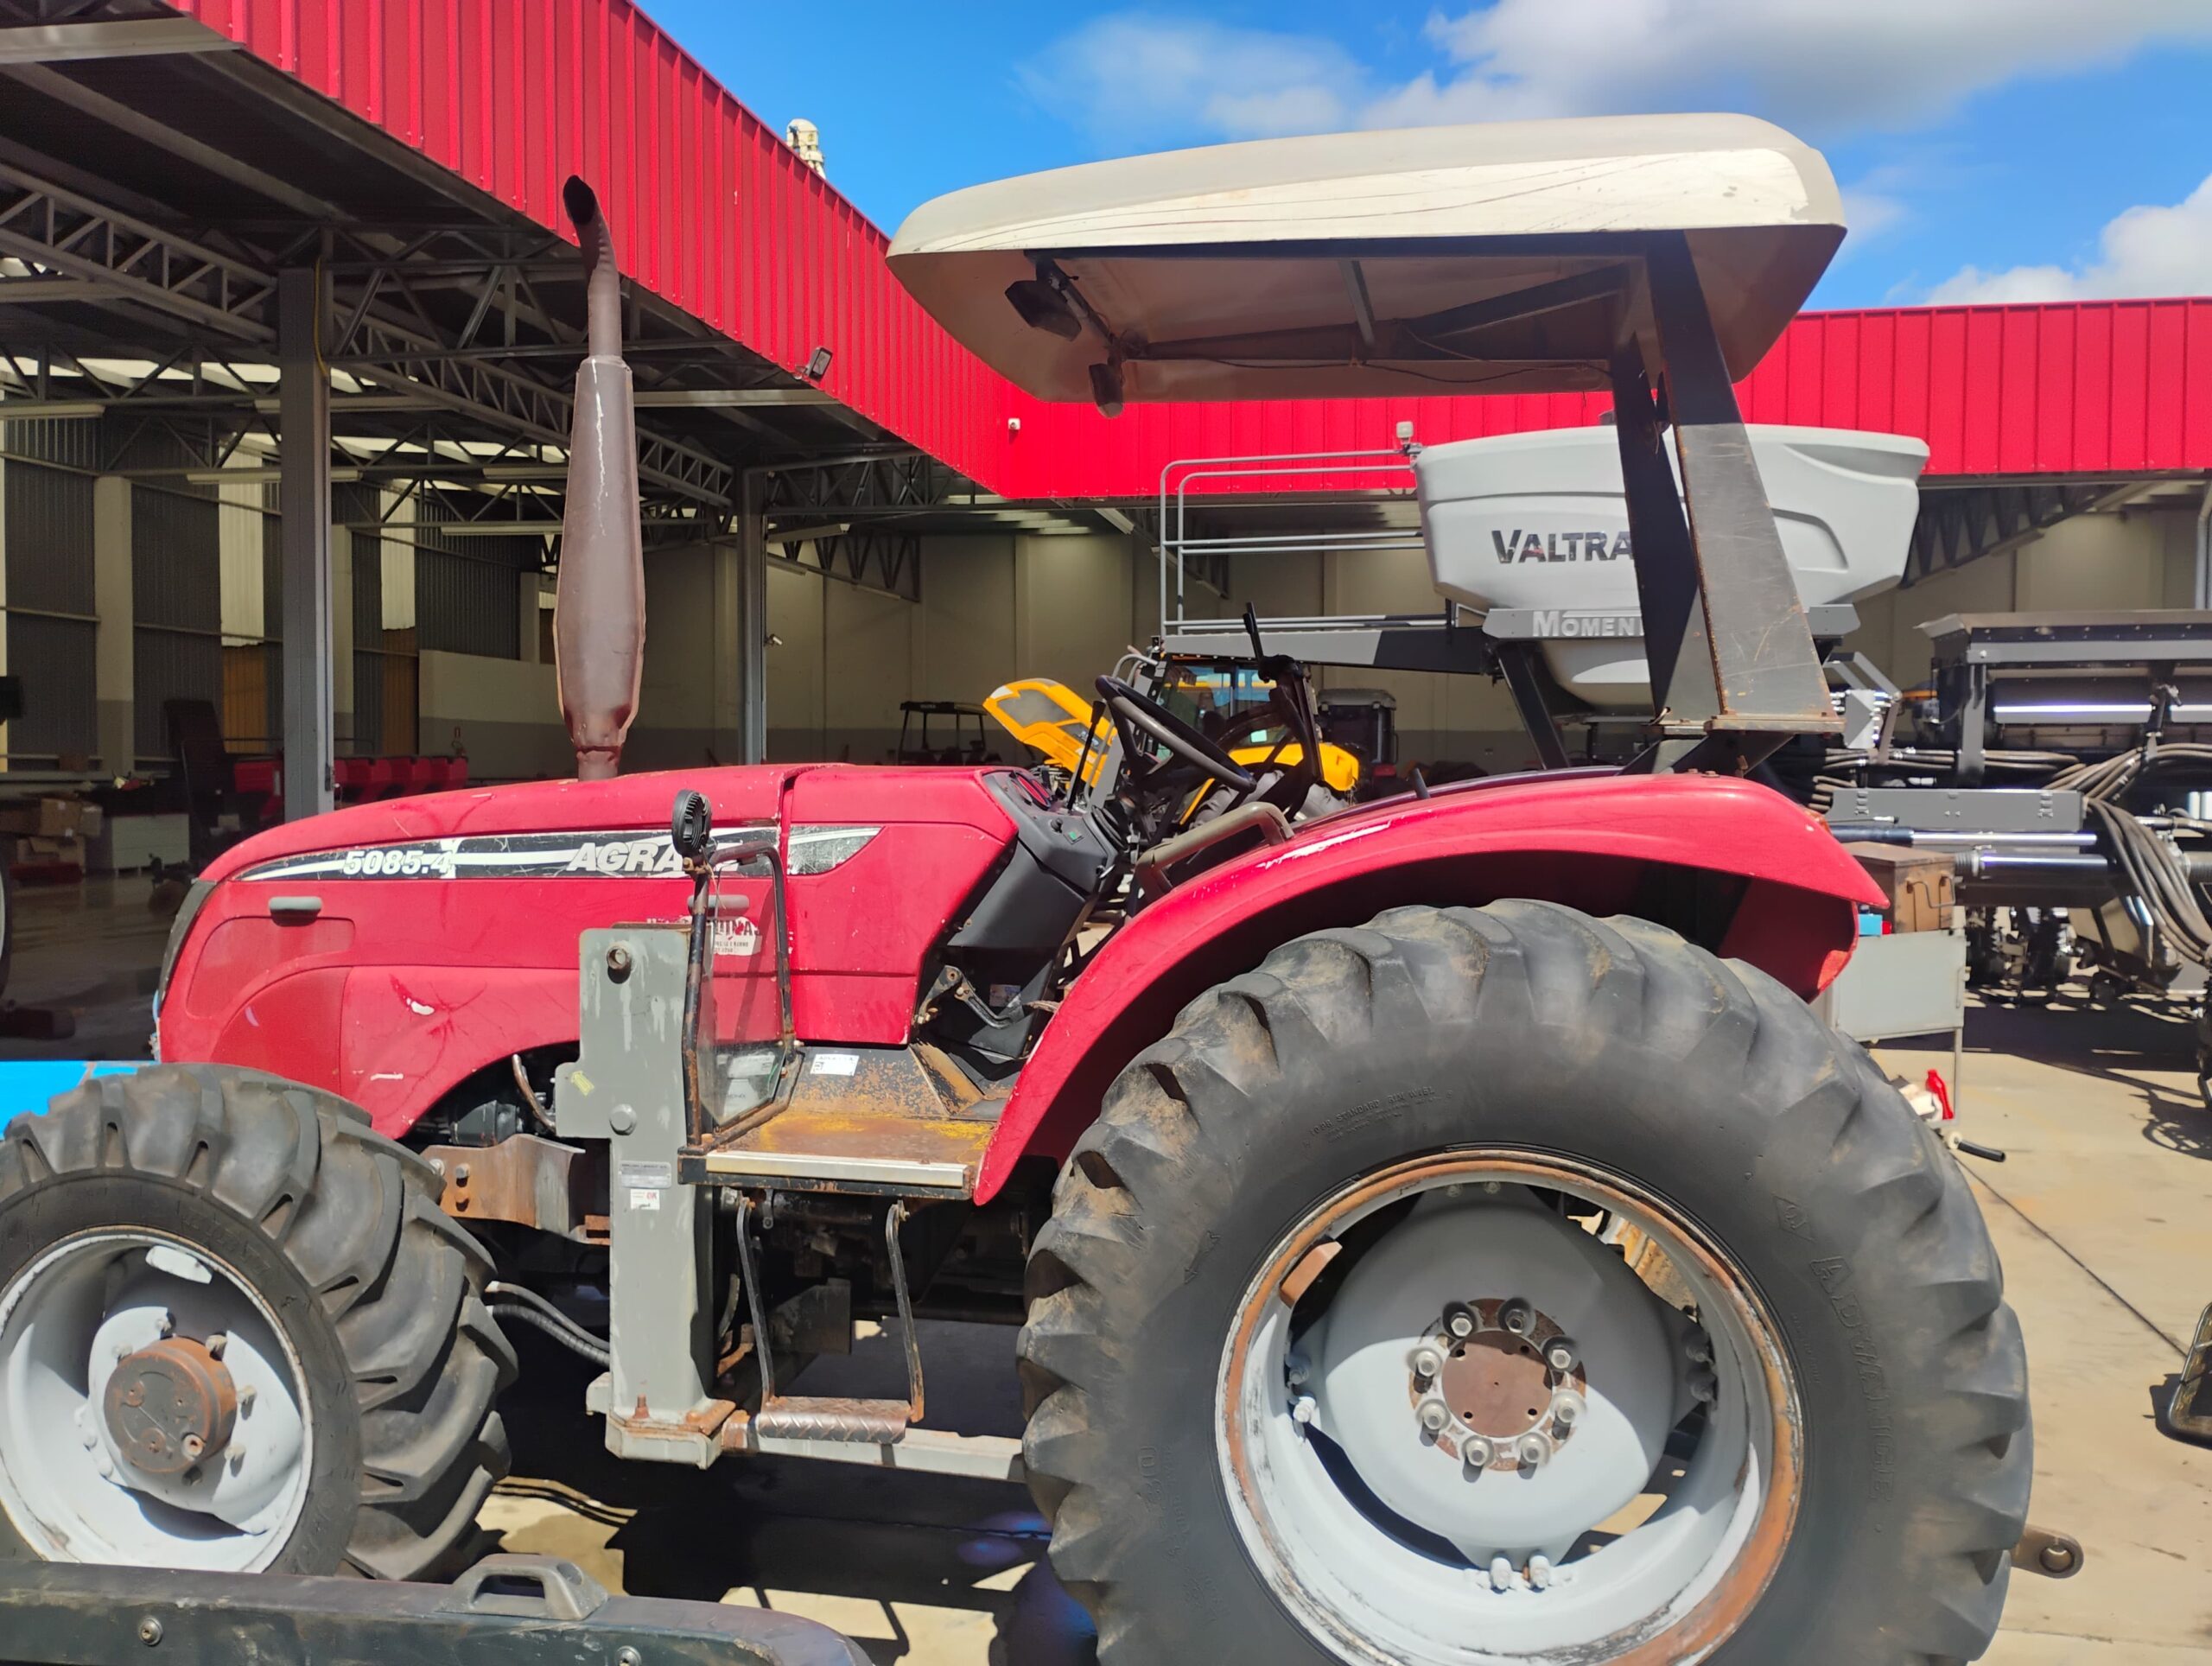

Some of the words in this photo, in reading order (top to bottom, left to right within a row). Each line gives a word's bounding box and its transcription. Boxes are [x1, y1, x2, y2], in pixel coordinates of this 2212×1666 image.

[1491, 530, 1634, 563] VALTRA
[1532, 609, 1644, 637] MOMEN
[343, 849, 454, 875] 5085.4
[566, 842, 741, 872] AGRA
[1336, 1098, 1381, 1122] STANDARD
[1809, 1256, 1896, 1502] ADVANCE
